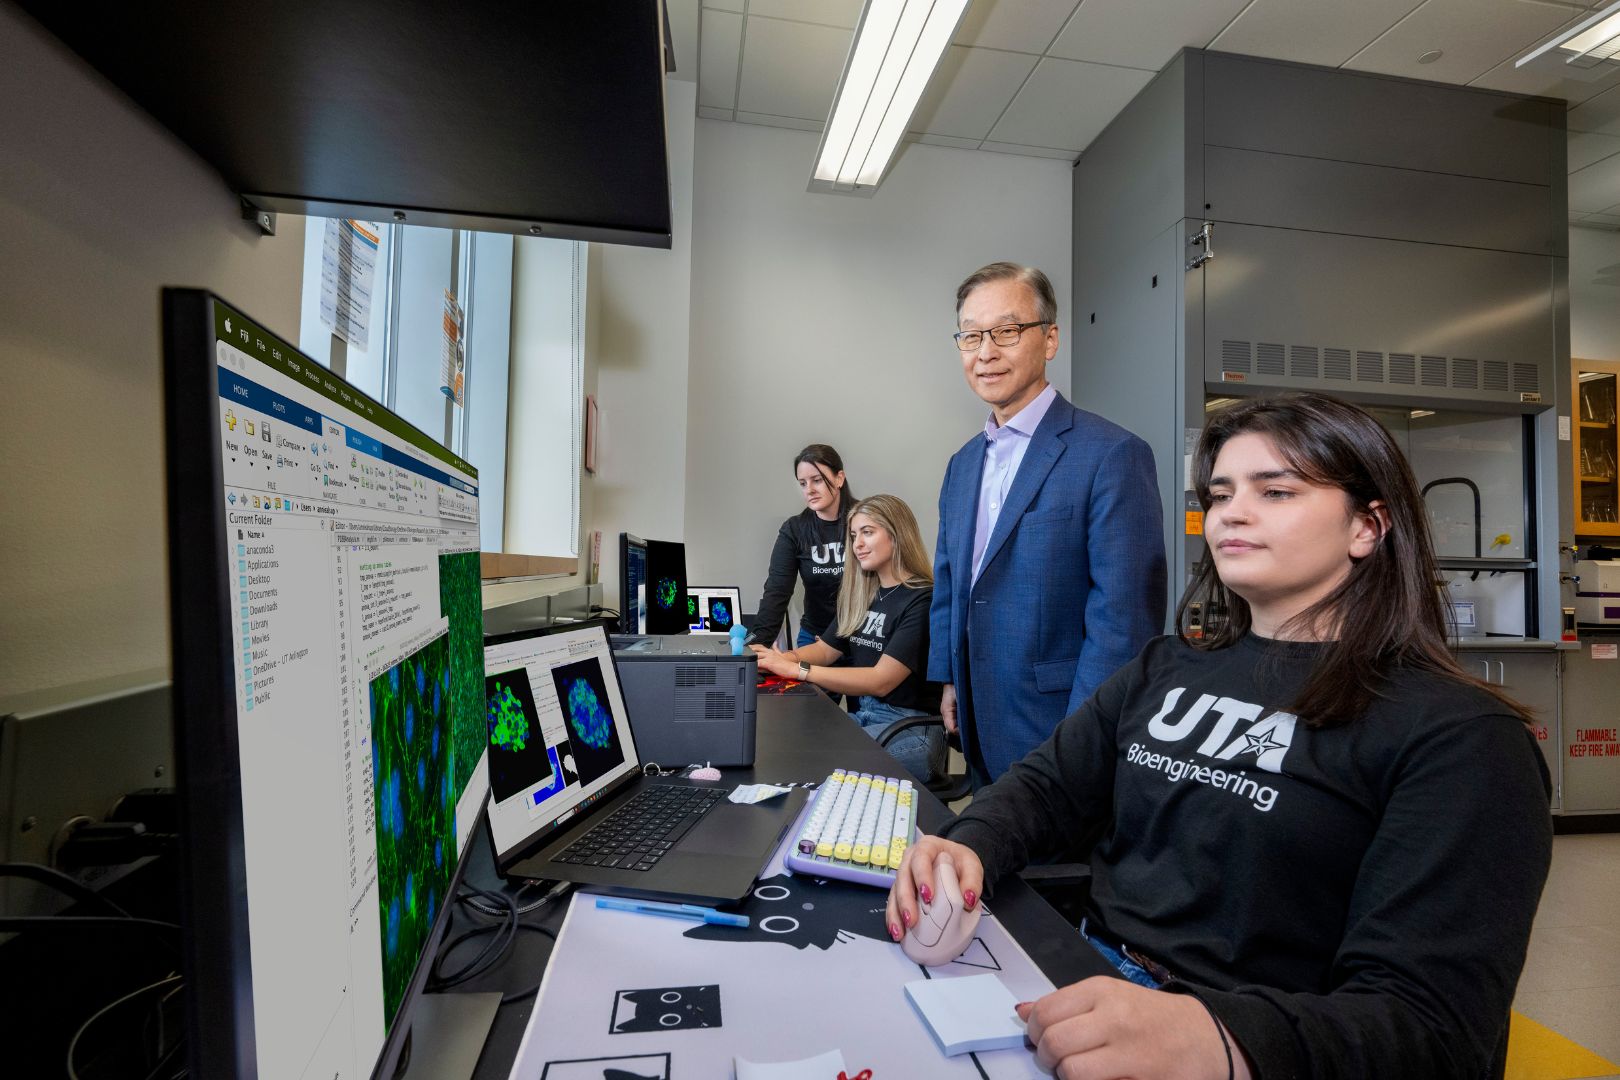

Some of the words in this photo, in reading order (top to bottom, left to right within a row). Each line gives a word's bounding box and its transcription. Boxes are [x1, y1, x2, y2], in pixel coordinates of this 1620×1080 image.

[240, 329, 249, 344] Fiji
[256, 338, 266, 351] File
[272, 348, 282, 361] Edit
[287, 357, 300, 372] Image
[305, 368, 320, 384] Process
[233, 384, 249, 398] HOME
[272, 401, 286, 414] PLOTS
[226, 440, 239, 452] New
[243, 444, 258, 457] Open
[282, 438, 301, 452] Compare
[261, 449, 273, 461] Save
[267, 481, 277, 491] FILE
[229, 512, 254, 525] Current
[254, 514, 272, 526] Folder
[247, 530, 261, 539] Name
[246, 544, 275, 555] anaconda3
[247, 559, 279, 572] Applications
[812, 566, 845, 575] Bioengin
[248, 575, 271, 585] Desktop
[249, 588, 278, 600] Documents
[249, 601, 278, 616] Downloads
[250, 619, 269, 631] Library
[862, 610, 886, 638] TA
[251, 633, 270, 646] Movies
[850, 635, 883, 652] oengineering
[252, 648, 268, 661] Music
[253, 660, 277, 676] OneDrive
[281, 653, 288, 665] UT
[253, 675, 275, 690] Pictures
[254, 691, 271, 705] Public
[1148, 687, 1298, 774] UTA
[1576, 729, 1617, 743] FLAMMABLE
[1569, 745, 1587, 757] KEEP
[1588, 745, 1603, 757] FIRE
[1605, 744, 1620, 756] AWA
[1127, 743, 1279, 812] Bioengineering
